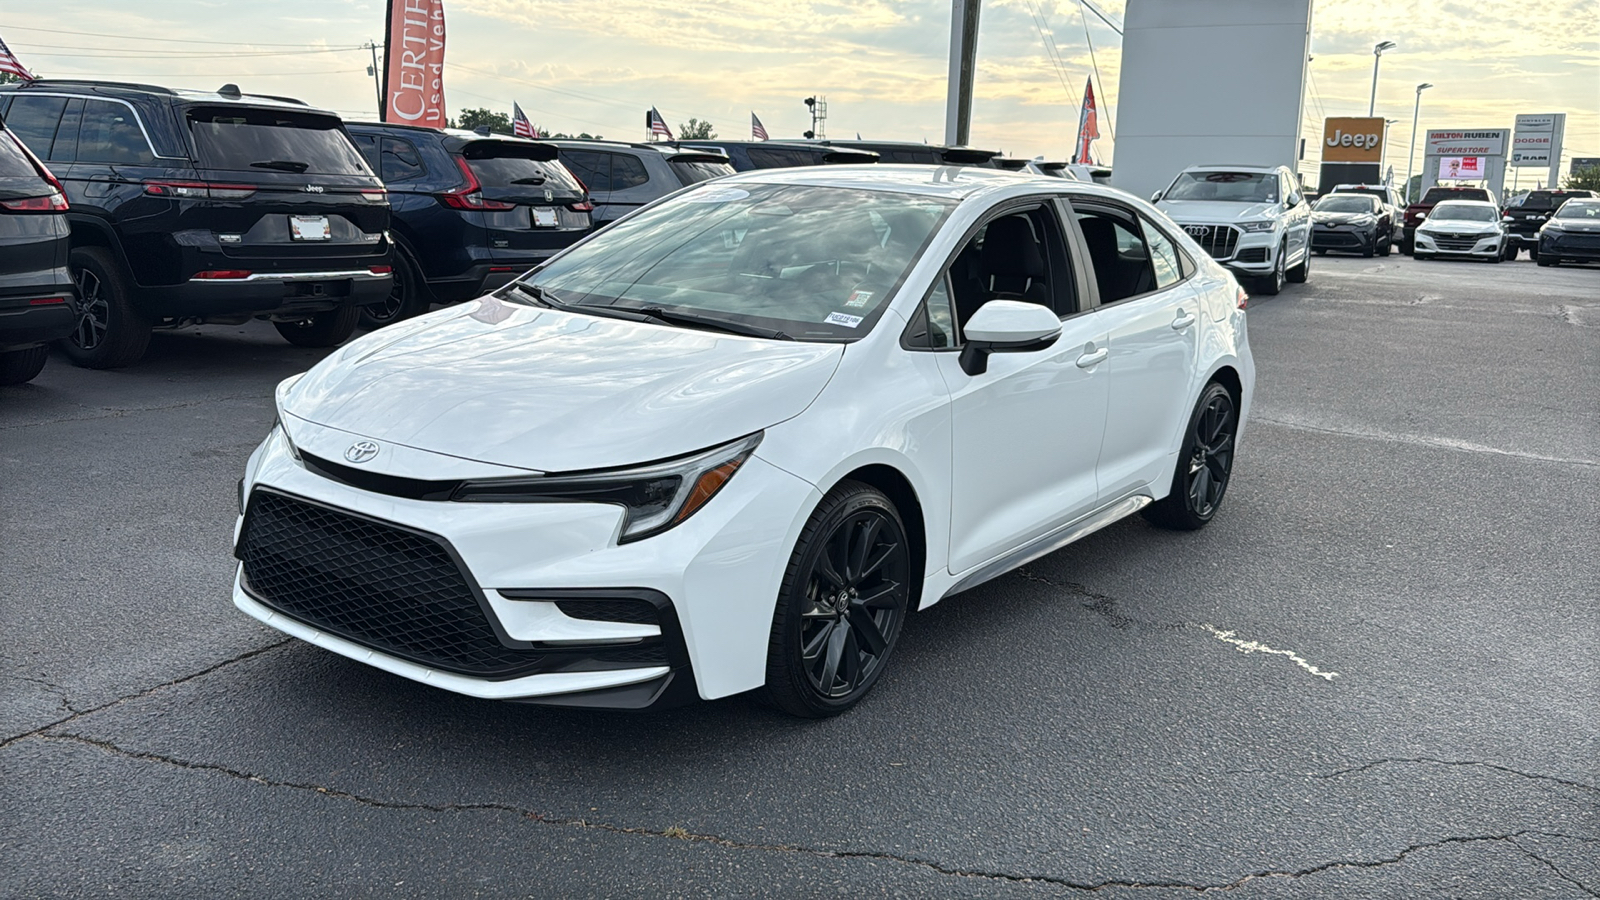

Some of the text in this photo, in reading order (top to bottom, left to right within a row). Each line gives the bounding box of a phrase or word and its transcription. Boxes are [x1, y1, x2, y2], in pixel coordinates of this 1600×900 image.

[426, 63, 442, 121] Used
[1326, 129, 1379, 151] Jeep
[305, 184, 324, 194] Jeep
